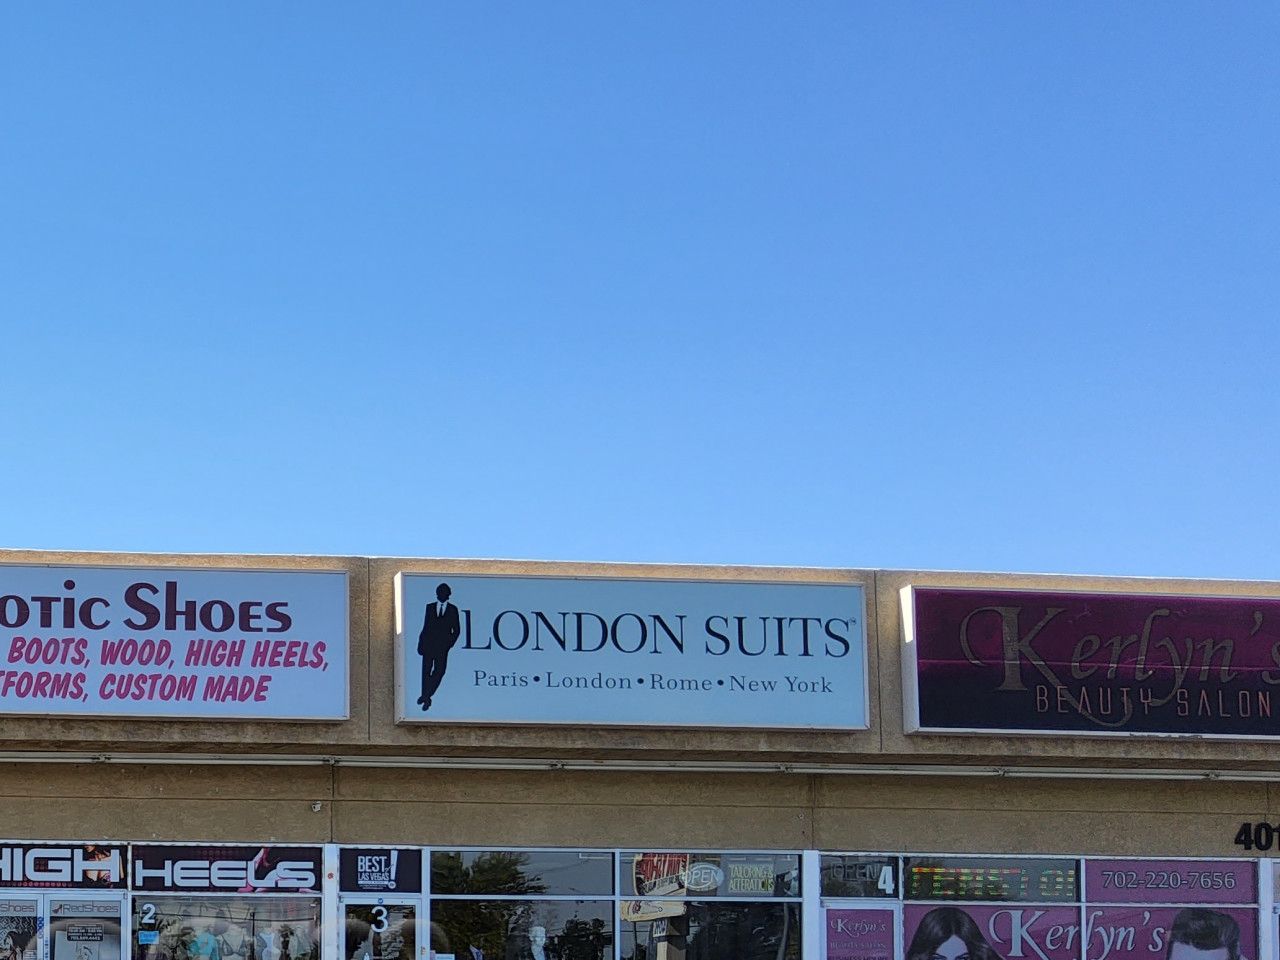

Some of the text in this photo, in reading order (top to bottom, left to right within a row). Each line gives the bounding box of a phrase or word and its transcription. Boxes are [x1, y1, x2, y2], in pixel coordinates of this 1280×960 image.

[460, 609, 851, 659] LONDON SUITS
[7, 637, 90, 669] BOOTS,
[99, 639, 175, 669] WOOD,
[185, 639, 243, 668] HIGH
[251, 640, 329, 671] HEELS,
[99, 673, 198, 702] CUSTOM
[203, 675, 272, 702] MADE
[473, 669, 833, 694] Paris London Rome New York
[1035, 685, 1271, 718] BEAUTY SALON
[135, 859, 316, 889] HEELS
[357, 856, 388, 873] BEST
[358, 872, 390, 881] LAS VEGAS
[683, 867, 721, 885] OPEN
[878, 865, 895, 894] 4
[1102, 871, 1236, 889] 702-220-7656
[141, 903, 156, 924] 2
[370, 905, 389, 932] 3
